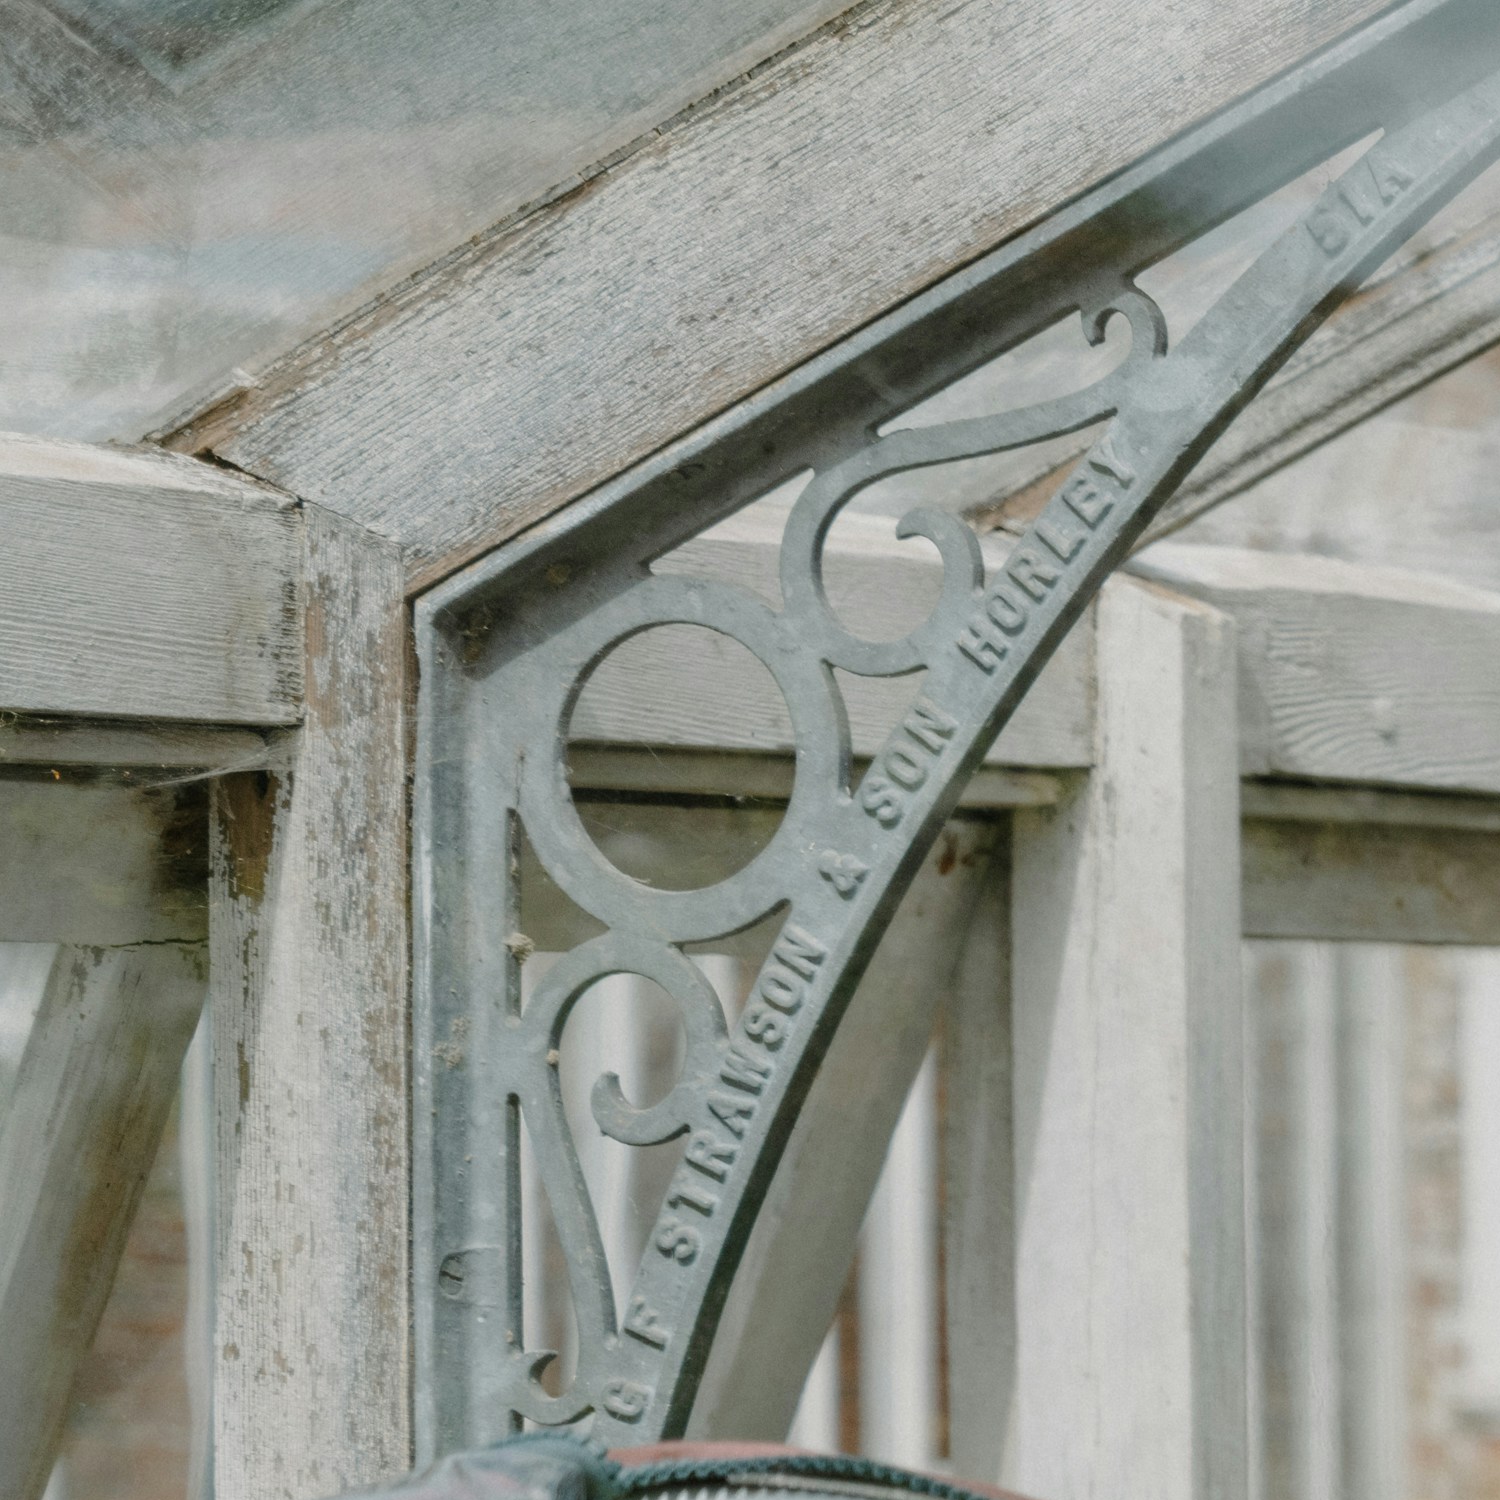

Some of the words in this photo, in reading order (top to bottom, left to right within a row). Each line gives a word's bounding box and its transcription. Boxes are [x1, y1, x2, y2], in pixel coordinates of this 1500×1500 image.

[956, 433, 1139, 674] HORLEY
[862, 698, 957, 830] SON
[818, 847, 870, 898] &
[656, 923, 828, 1266] STRAWSON
[623, 1295, 669, 1352] F
[603, 1379, 651, 1425] G
